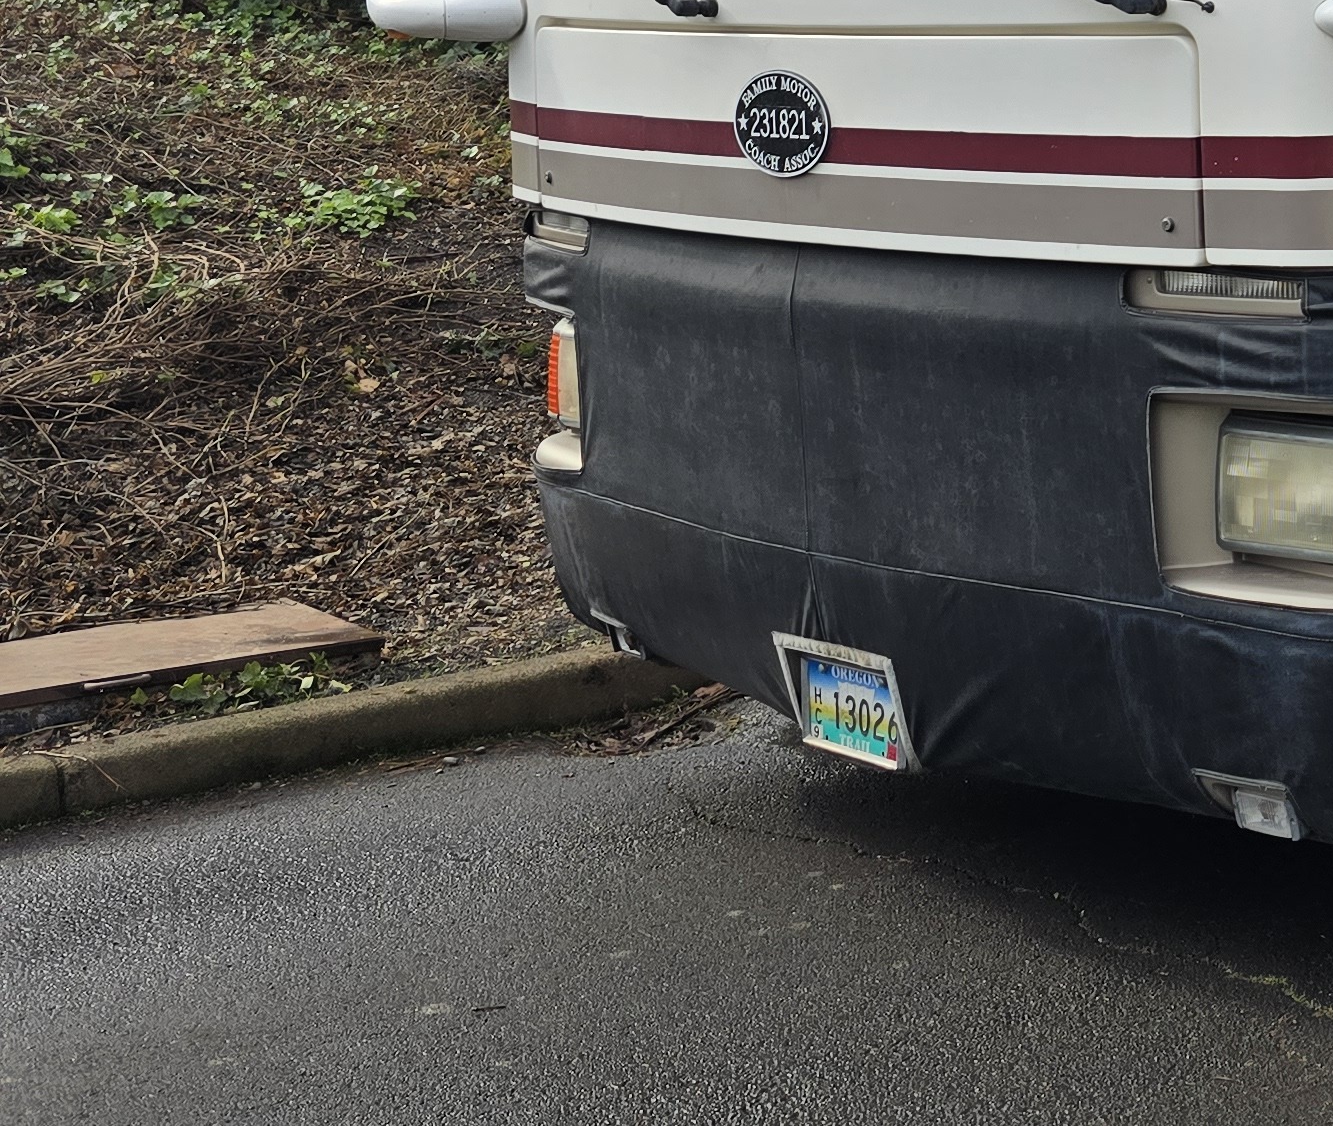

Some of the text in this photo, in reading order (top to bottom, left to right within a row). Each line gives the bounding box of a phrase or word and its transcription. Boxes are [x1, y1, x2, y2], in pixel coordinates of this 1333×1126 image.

[742, 76, 817, 111] FAMILY MOTOR
[750, 108, 810, 140] 231821
[745, 138, 780, 171] COACH
[831, 665, 880, 689] OREGON
[833, 691, 898, 745] 13026
